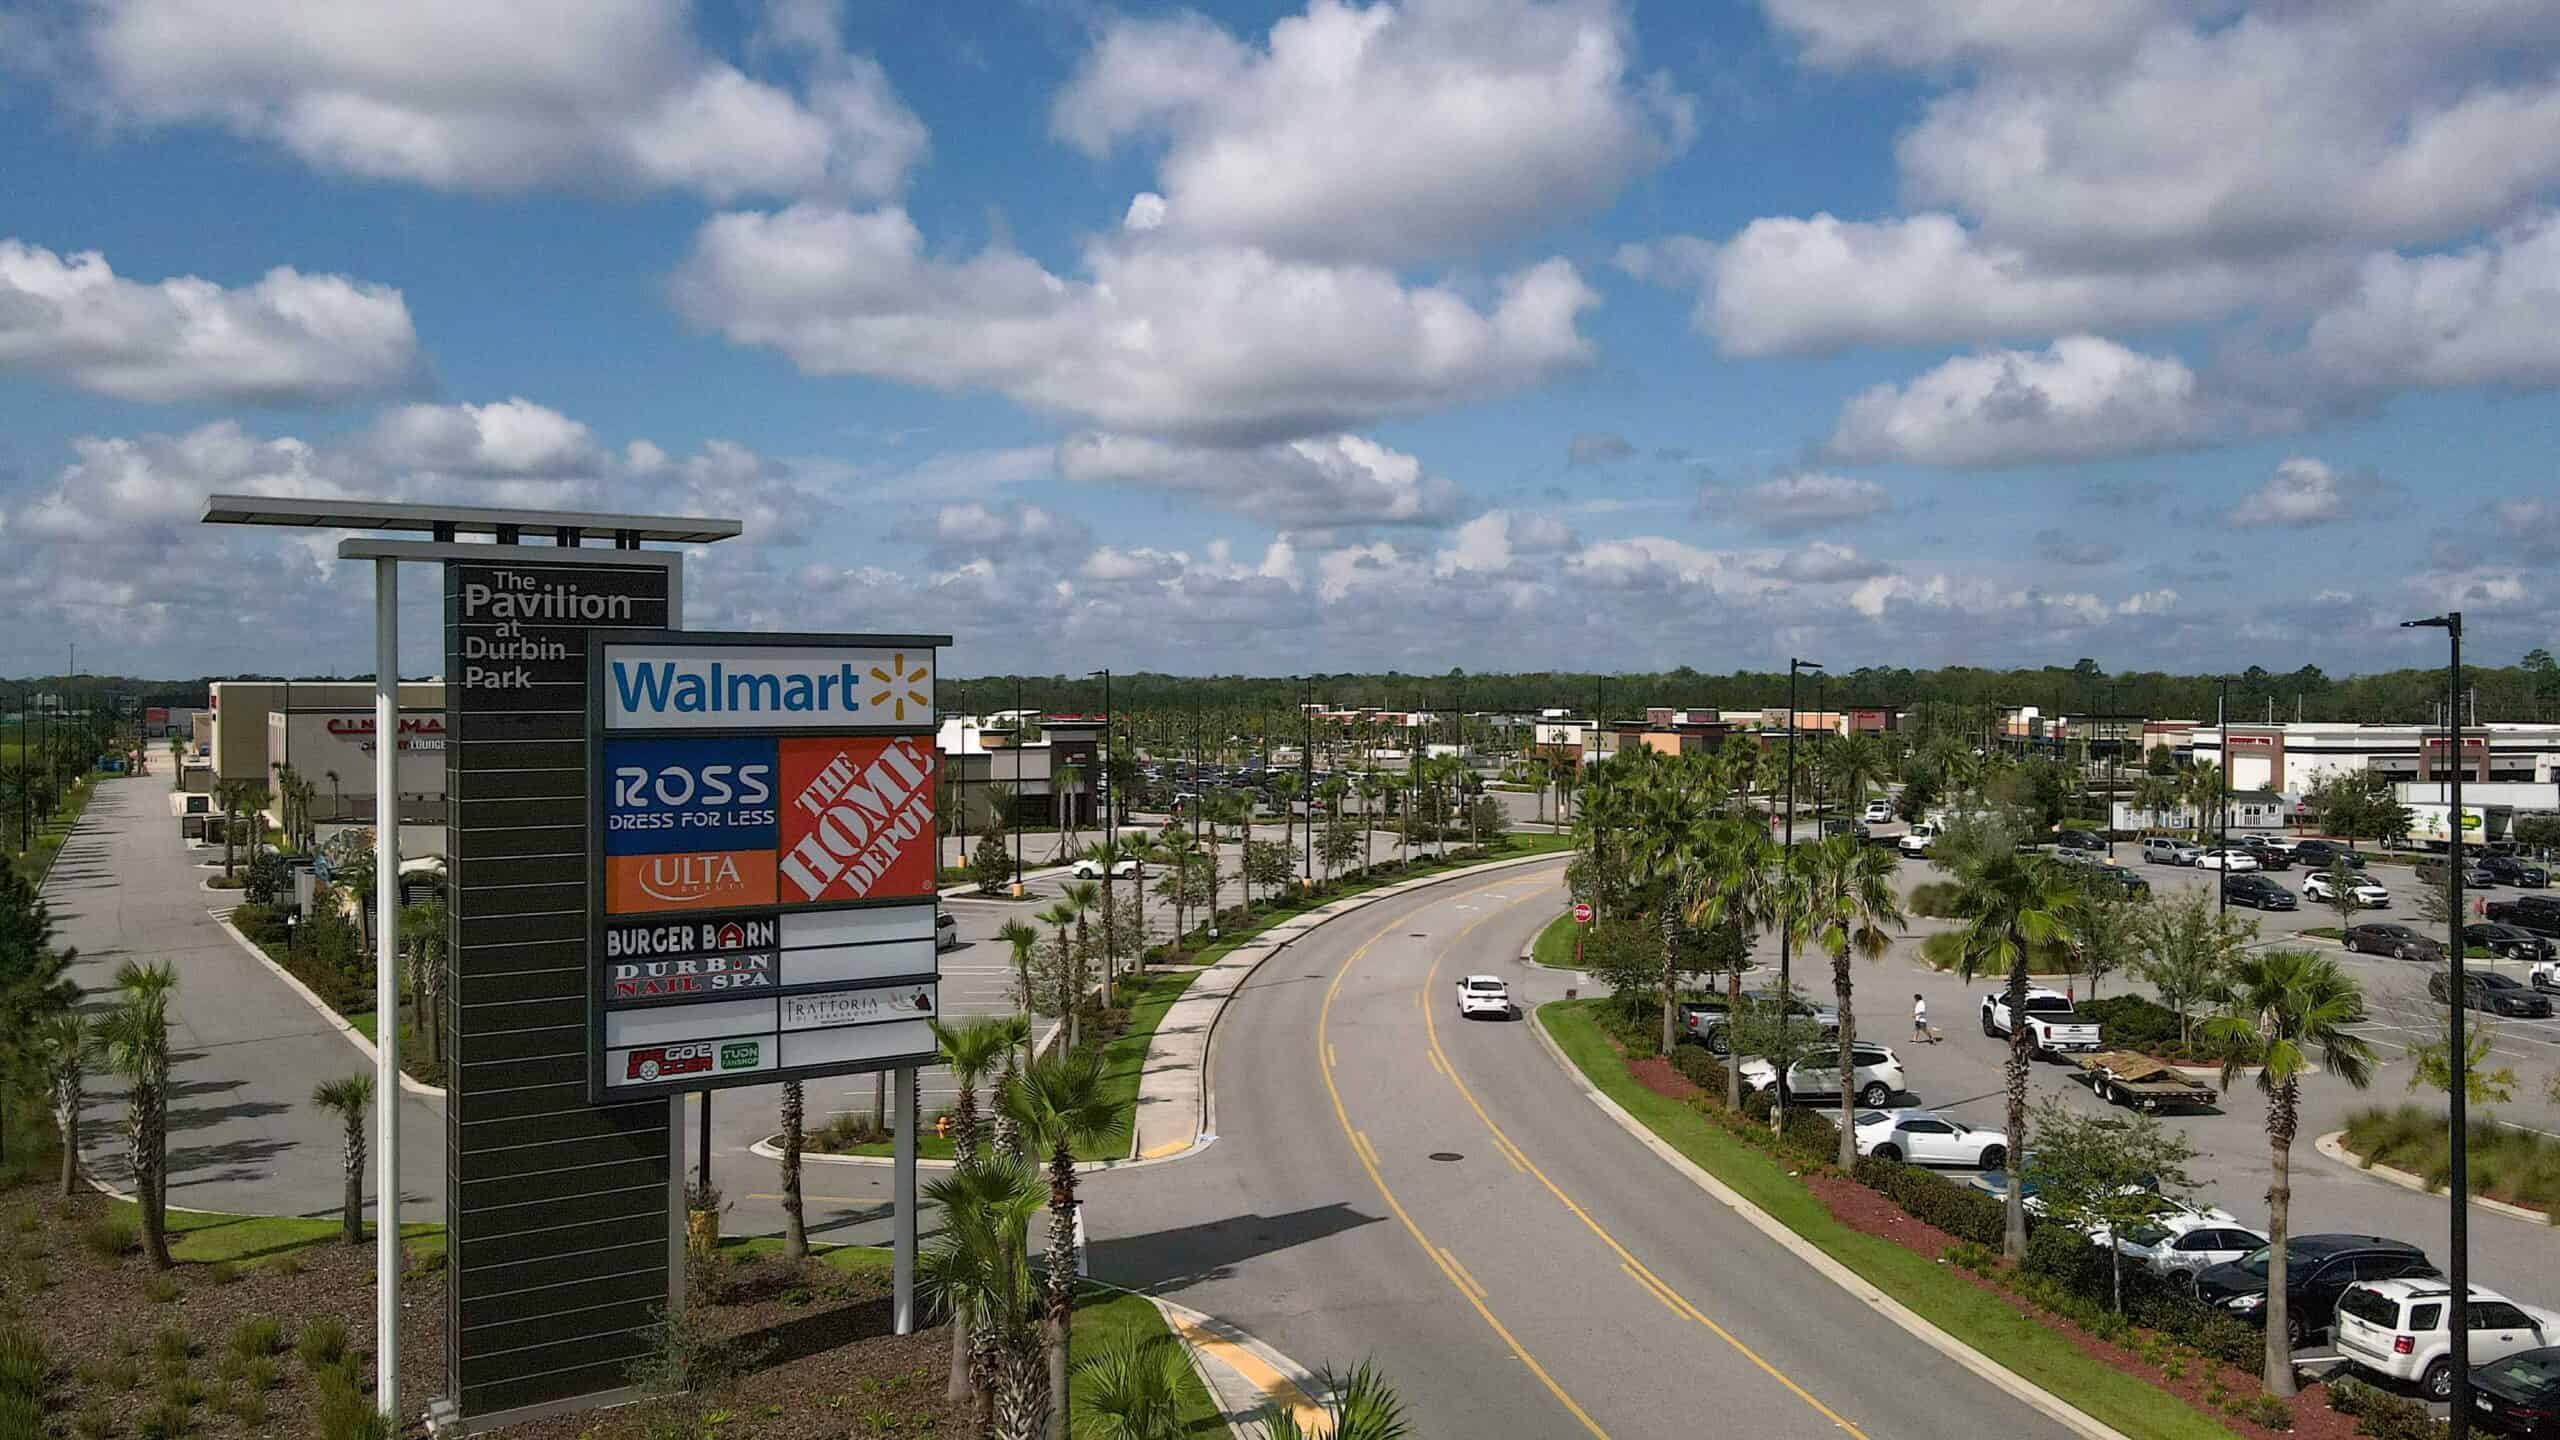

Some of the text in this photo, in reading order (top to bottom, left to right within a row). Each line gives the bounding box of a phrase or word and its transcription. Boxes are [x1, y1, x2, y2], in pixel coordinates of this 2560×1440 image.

[493, 571, 536, 590] The
[465, 583, 631, 619] Pavilion
[495, 618, 521, 637] at
[465, 636, 566, 660] Durbin
[465, 665, 533, 689] Park
[612, 661, 860, 713] Walmart
[615, 764, 769, 807] ROSS
[793, 751, 861, 818] THE
[609, 810, 775, 830] DRESS FOR LESS
[779, 736, 935, 902] HOME
[841, 792, 935, 898] DEPOT
[655, 855, 741, 886] ULTA
[607, 925, 695, 957] BURGER
[615, 972, 770, 1000] NAIL SPA
